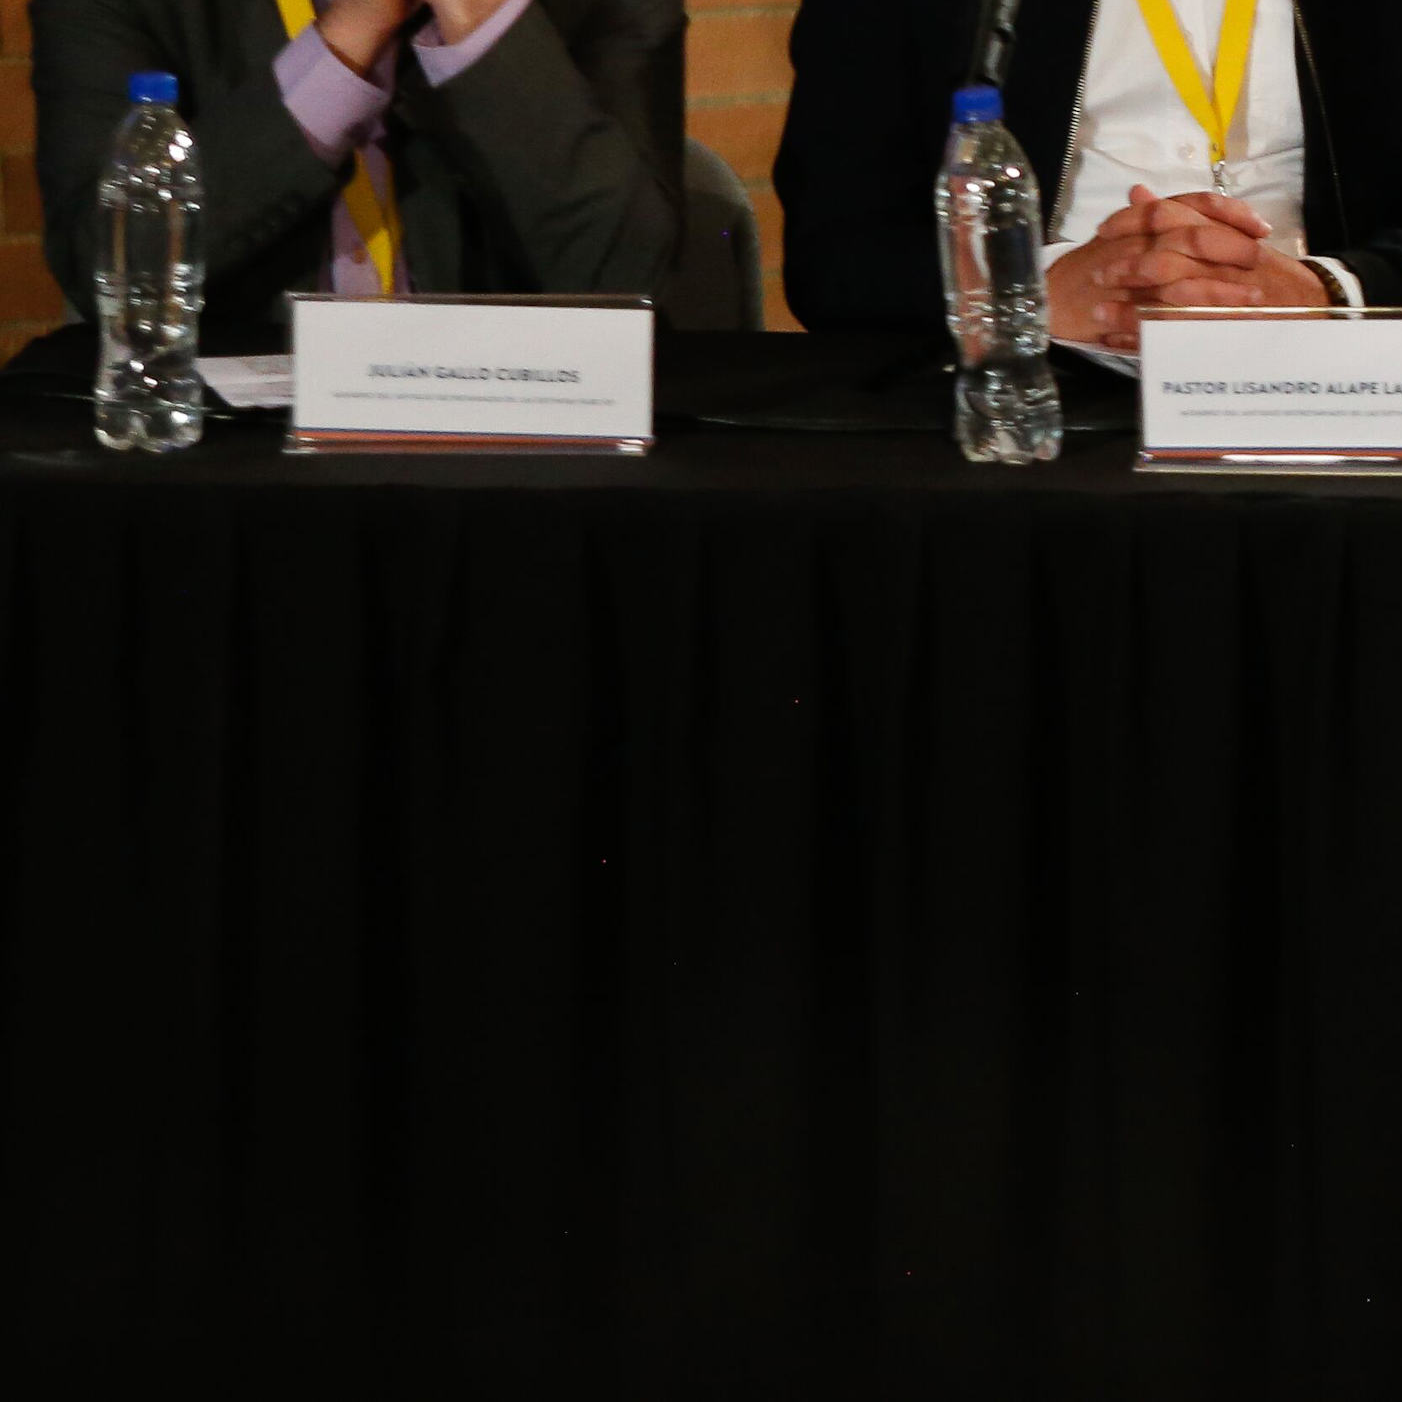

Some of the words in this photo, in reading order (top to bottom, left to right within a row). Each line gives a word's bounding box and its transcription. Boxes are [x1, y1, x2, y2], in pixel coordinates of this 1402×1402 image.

[434, 365, 489, 380] GALLO
[495, 367, 580, 383] CUBILLOS
[1162, 381, 1228, 395] PASTOR
[1231, 381, 1321, 395] LISANDRO
[1326, 381, 1378, 395] ALAPE
